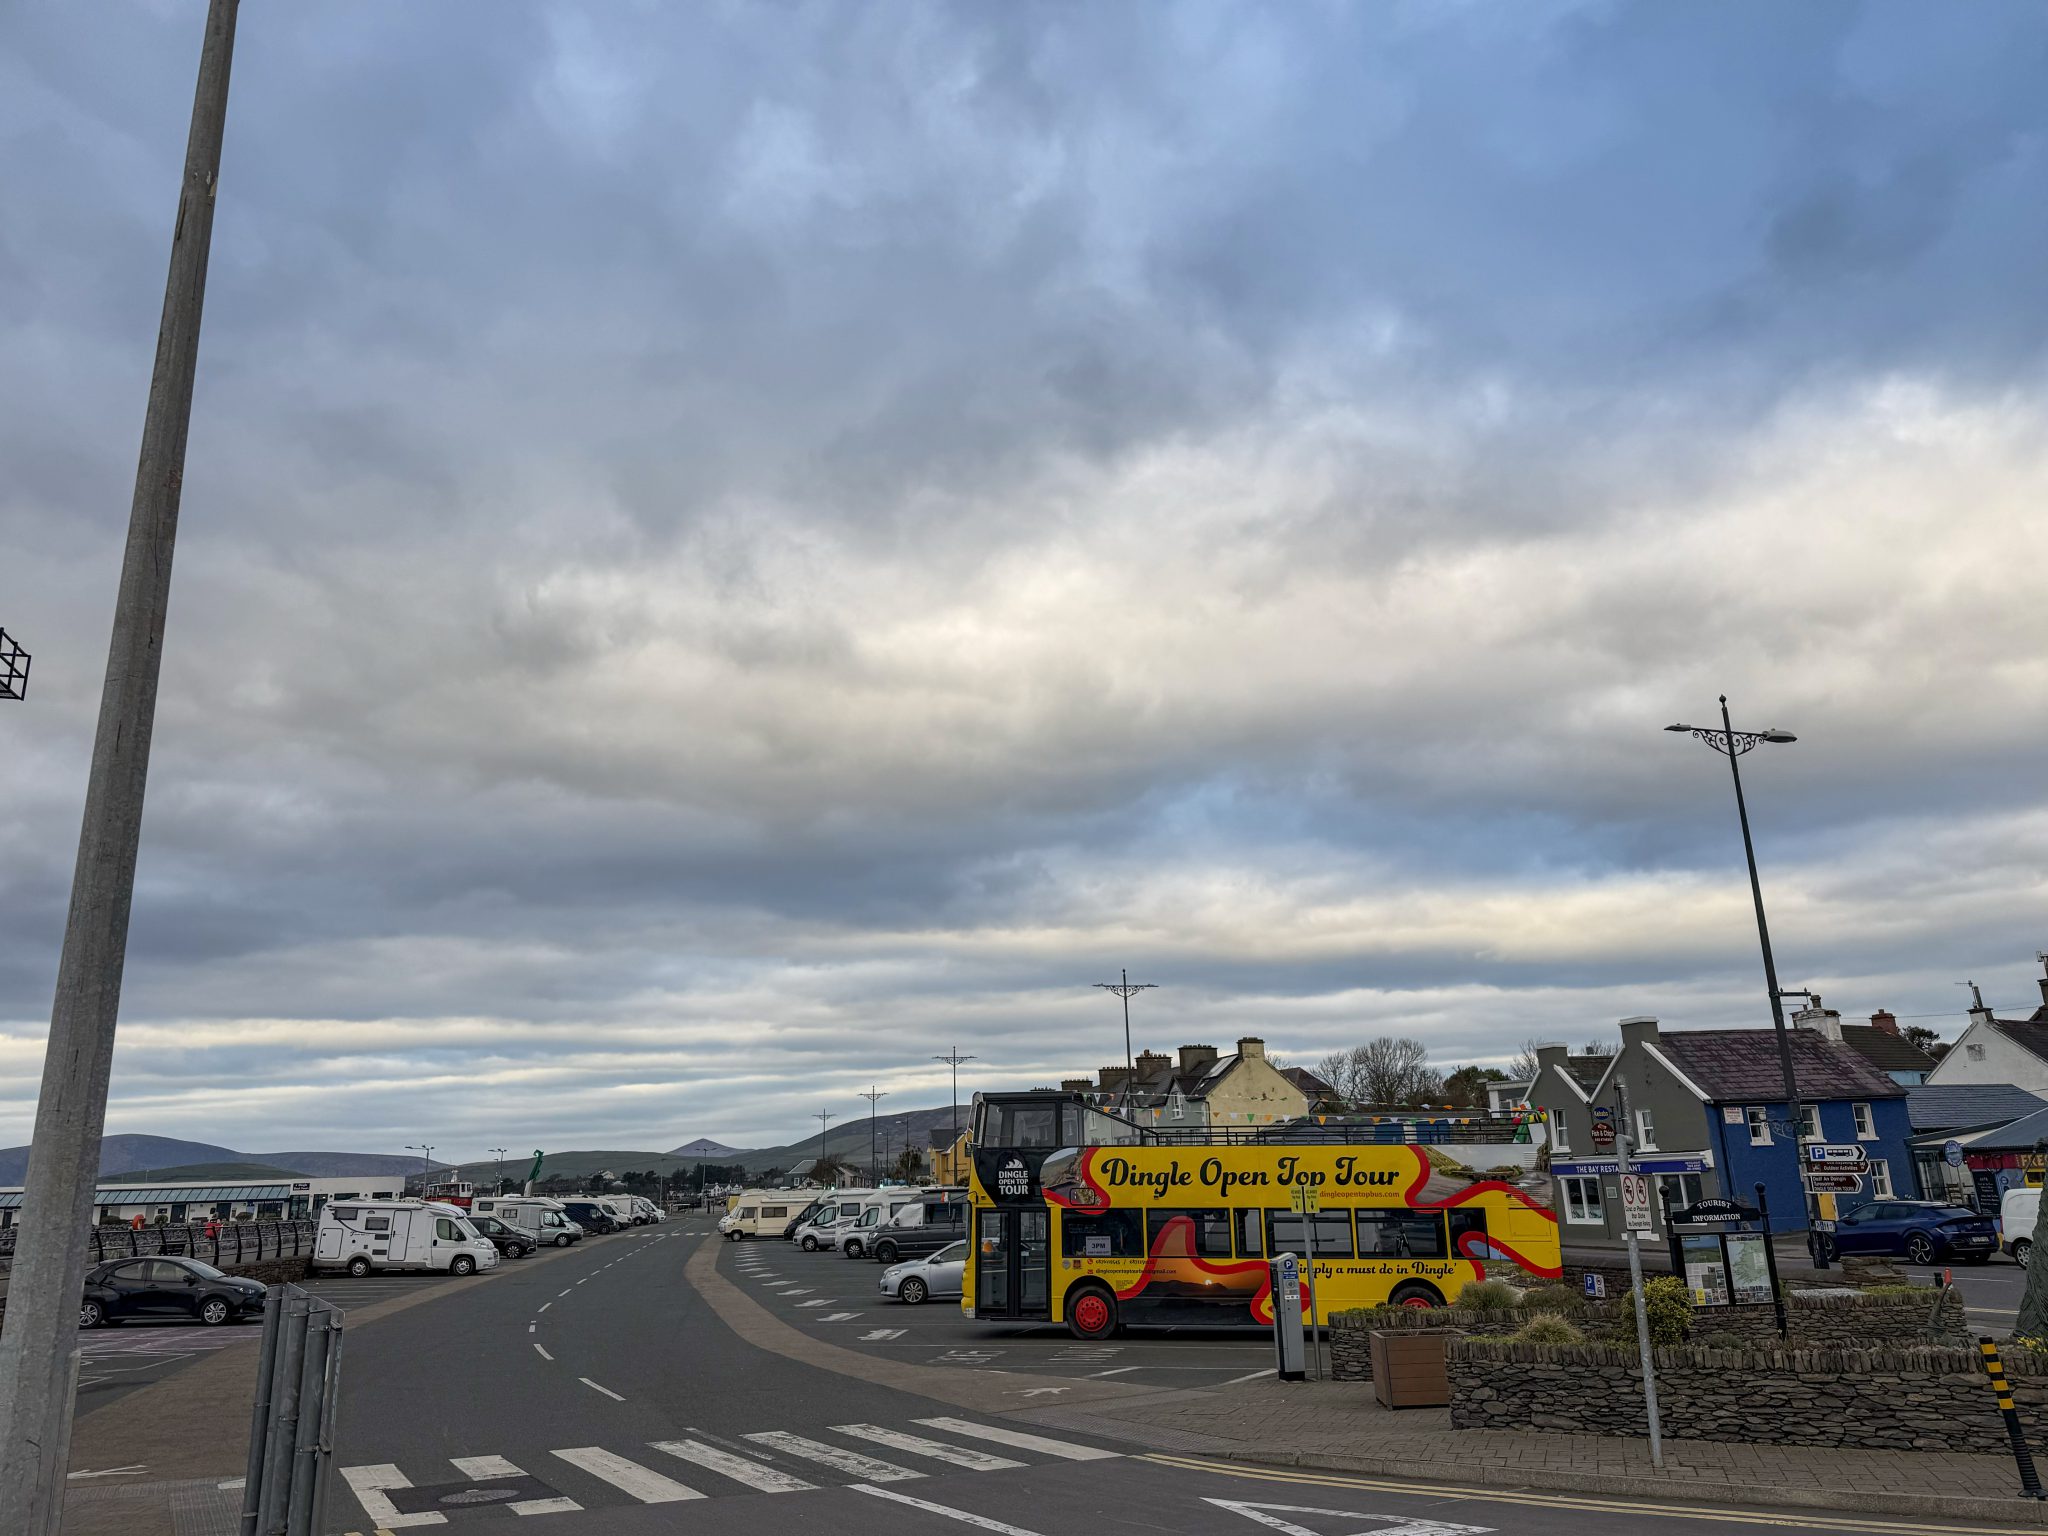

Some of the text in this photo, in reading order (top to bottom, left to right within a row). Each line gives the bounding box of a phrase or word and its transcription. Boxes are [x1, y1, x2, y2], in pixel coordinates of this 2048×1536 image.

[1604, 1130, 1615, 1138] Chips
[1815, 1148, 1823, 1159] P
[1575, 1164, 1641, 1174] THE BAY RESTAANT
[998, 1170, 1029, 1179] DINGLE
[1100, 1156, 1400, 1198] Dingle Open Top Tour
[998, 1185, 1029, 1195] TOUR
[1319, 1189, 1400, 1199] dingleopentopbus.com
[1696, 1199, 1732, 1209] TOURIST
[1692, 1213, 1741, 1222] INFORMATION
[1346, 1263, 1376, 1275] must
[1379, 1263, 1393, 1275] do
[1396, 1263, 1409, 1275] in
